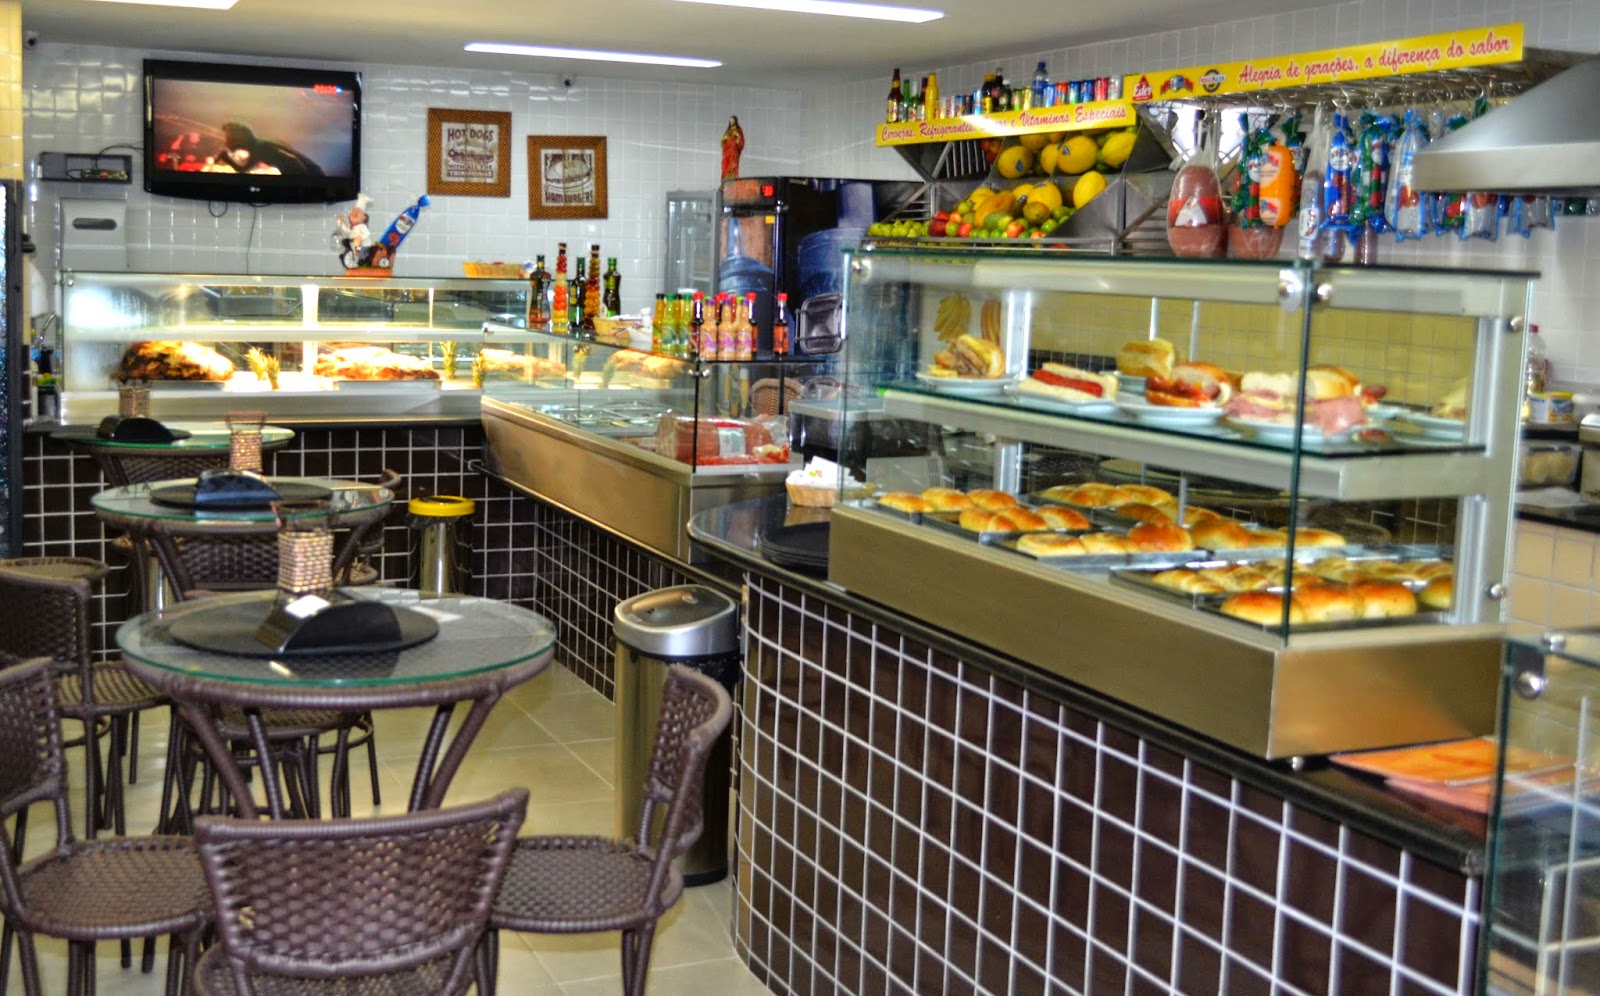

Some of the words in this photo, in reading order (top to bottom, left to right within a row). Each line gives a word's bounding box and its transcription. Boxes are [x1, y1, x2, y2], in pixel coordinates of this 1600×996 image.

[1239, 63, 1281, 87] Alegria
[1286, 61, 1300, 79] de
[1364, 57, 1374, 69] a
[1378, 45, 1441, 72] diferença
[1446, 38, 1464, 57] do
[1469, 31, 1510, 56] sabor
[1019, 111, 1070, 127] Vitaminas
[1075, 105, 1127, 123] Especiais
[447, 128, 466, 142] HOT
[470, 129, 494, 142] DOGS
[545, 189, 593, 204] HAMBURGERS
